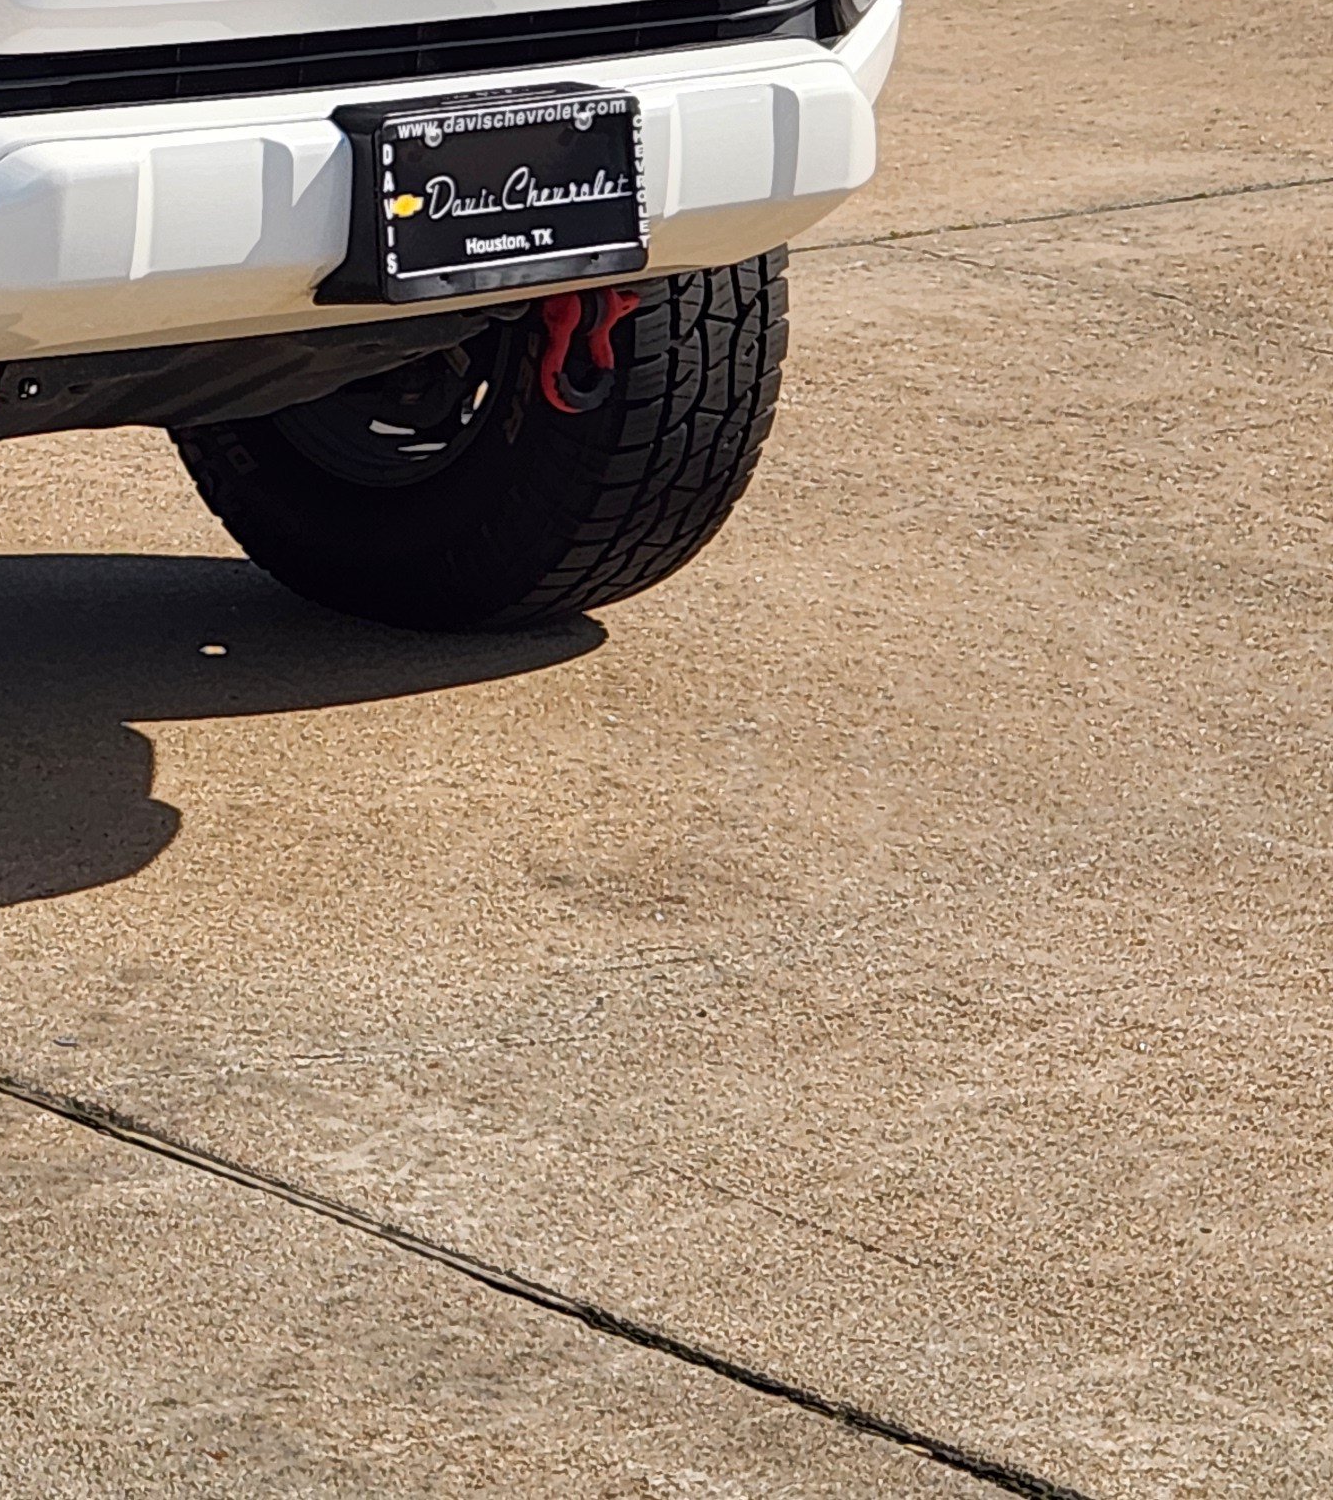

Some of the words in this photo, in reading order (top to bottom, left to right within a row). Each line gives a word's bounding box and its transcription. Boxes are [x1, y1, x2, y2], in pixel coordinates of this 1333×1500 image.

[382, 143, 398, 275] DAVIS
[426, 175, 502, 219] Davis
[502, 166, 633, 211] Chevrolet
[465, 233, 530, 255] Houston,
[531, 228, 554, 246] TX
